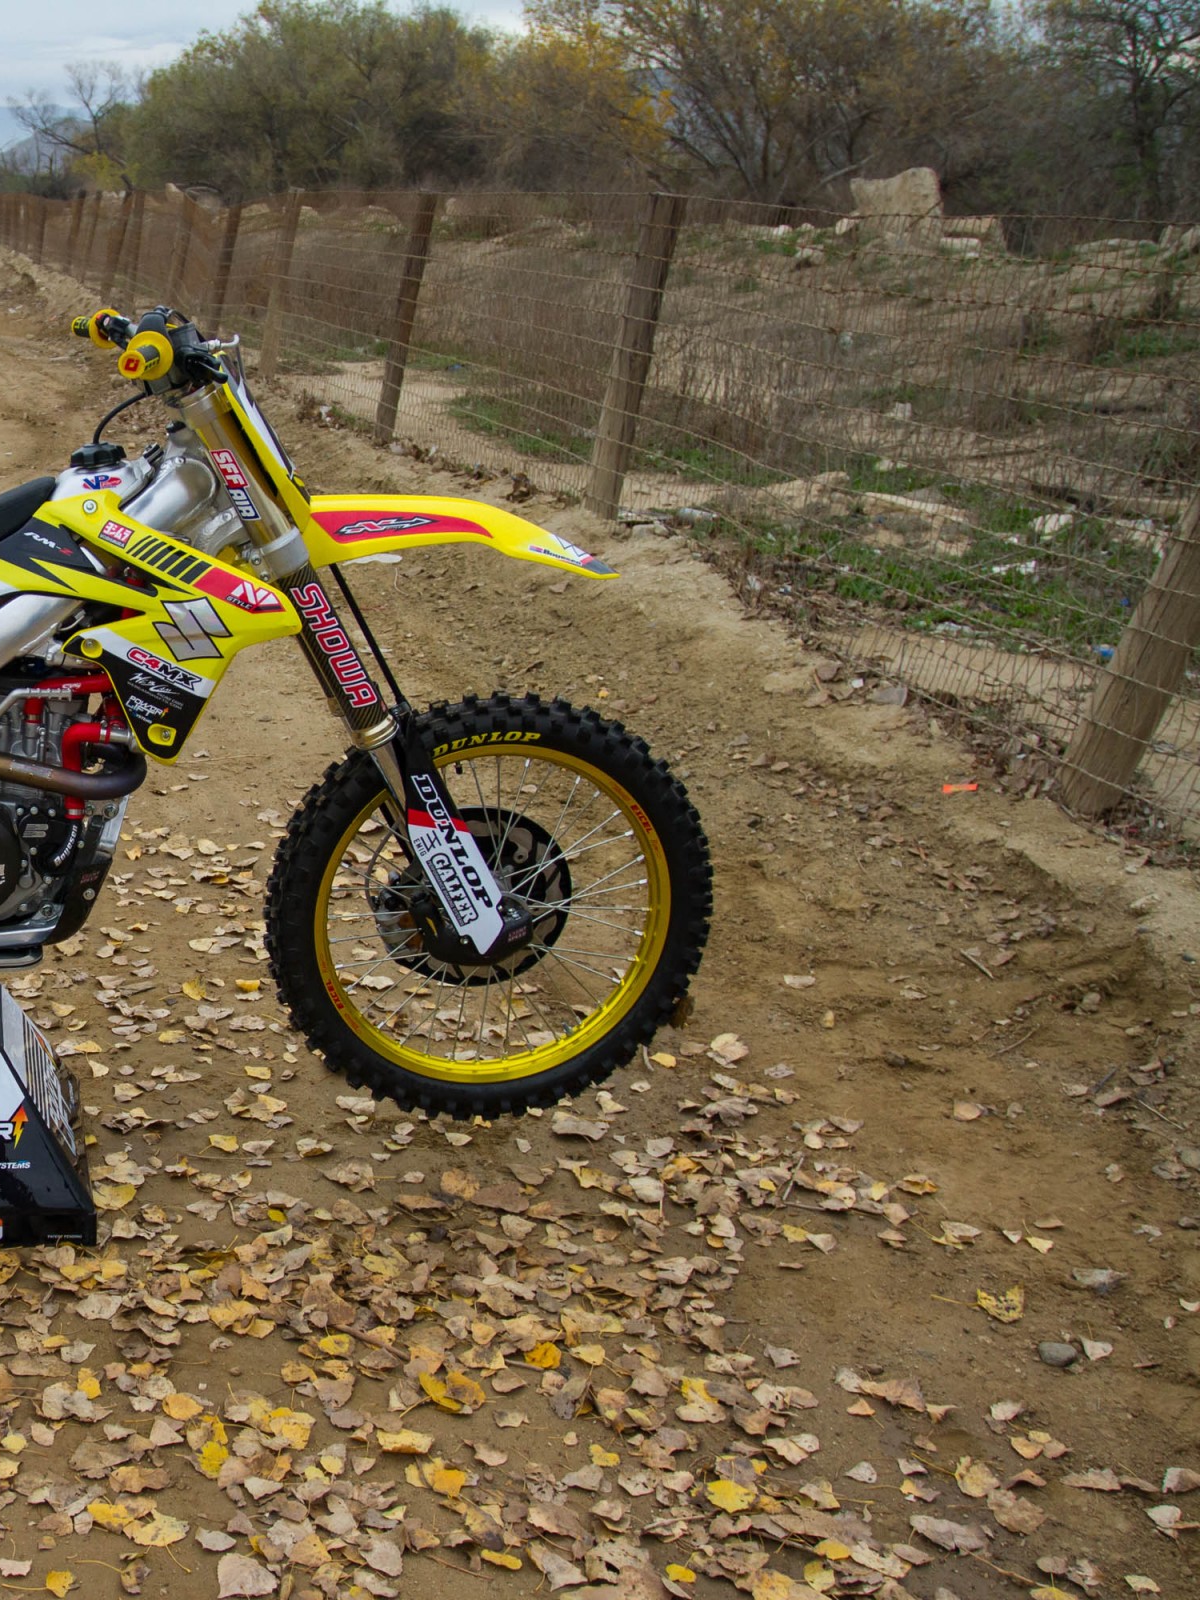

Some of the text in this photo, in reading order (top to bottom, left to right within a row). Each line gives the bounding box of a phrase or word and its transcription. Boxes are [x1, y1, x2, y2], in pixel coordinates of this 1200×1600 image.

[83, 475, 109, 489] VP
[213, 451, 257, 520] SFF AIR
[226, 595, 253, 610] STYLE
[290, 583, 377, 708] SHOWA
[128, 648, 202, 690] C4MX
[433, 731, 542, 757] DUNLOP
[410, 774, 493, 909] DUNLOP
[413, 838, 427, 857] EMIG
[432, 853, 478, 923] GALFER
